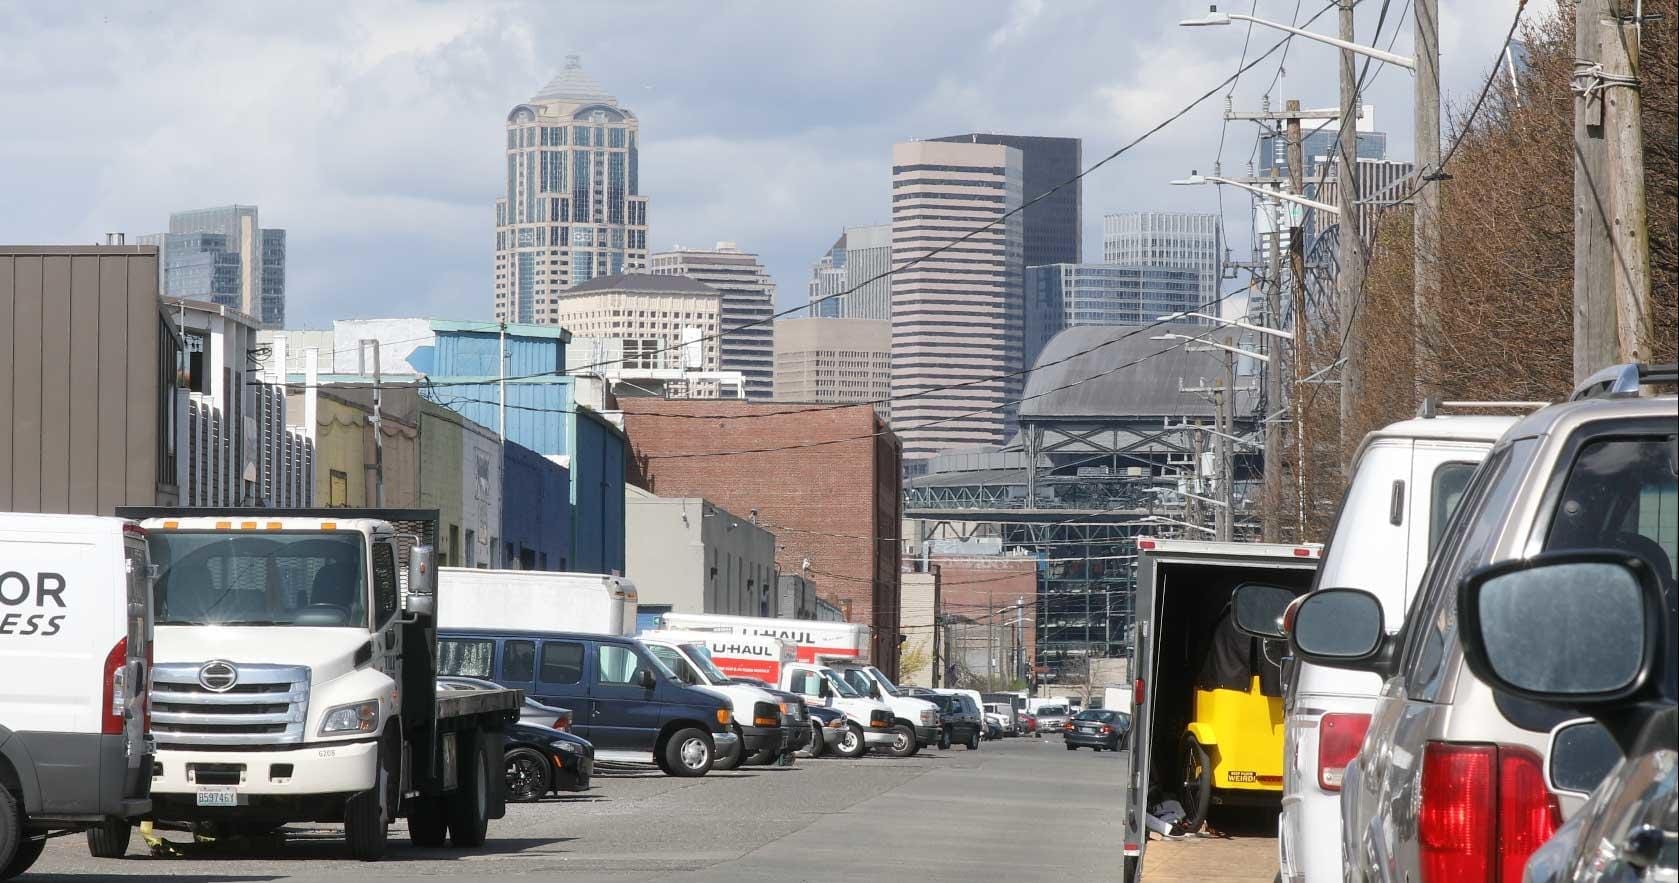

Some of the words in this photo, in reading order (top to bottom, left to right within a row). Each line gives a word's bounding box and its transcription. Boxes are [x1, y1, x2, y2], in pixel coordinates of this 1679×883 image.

[0, 571, 66, 607] OR
[0, 613, 66, 636] ESS
[713, 643, 773, 656] U-HAUL
